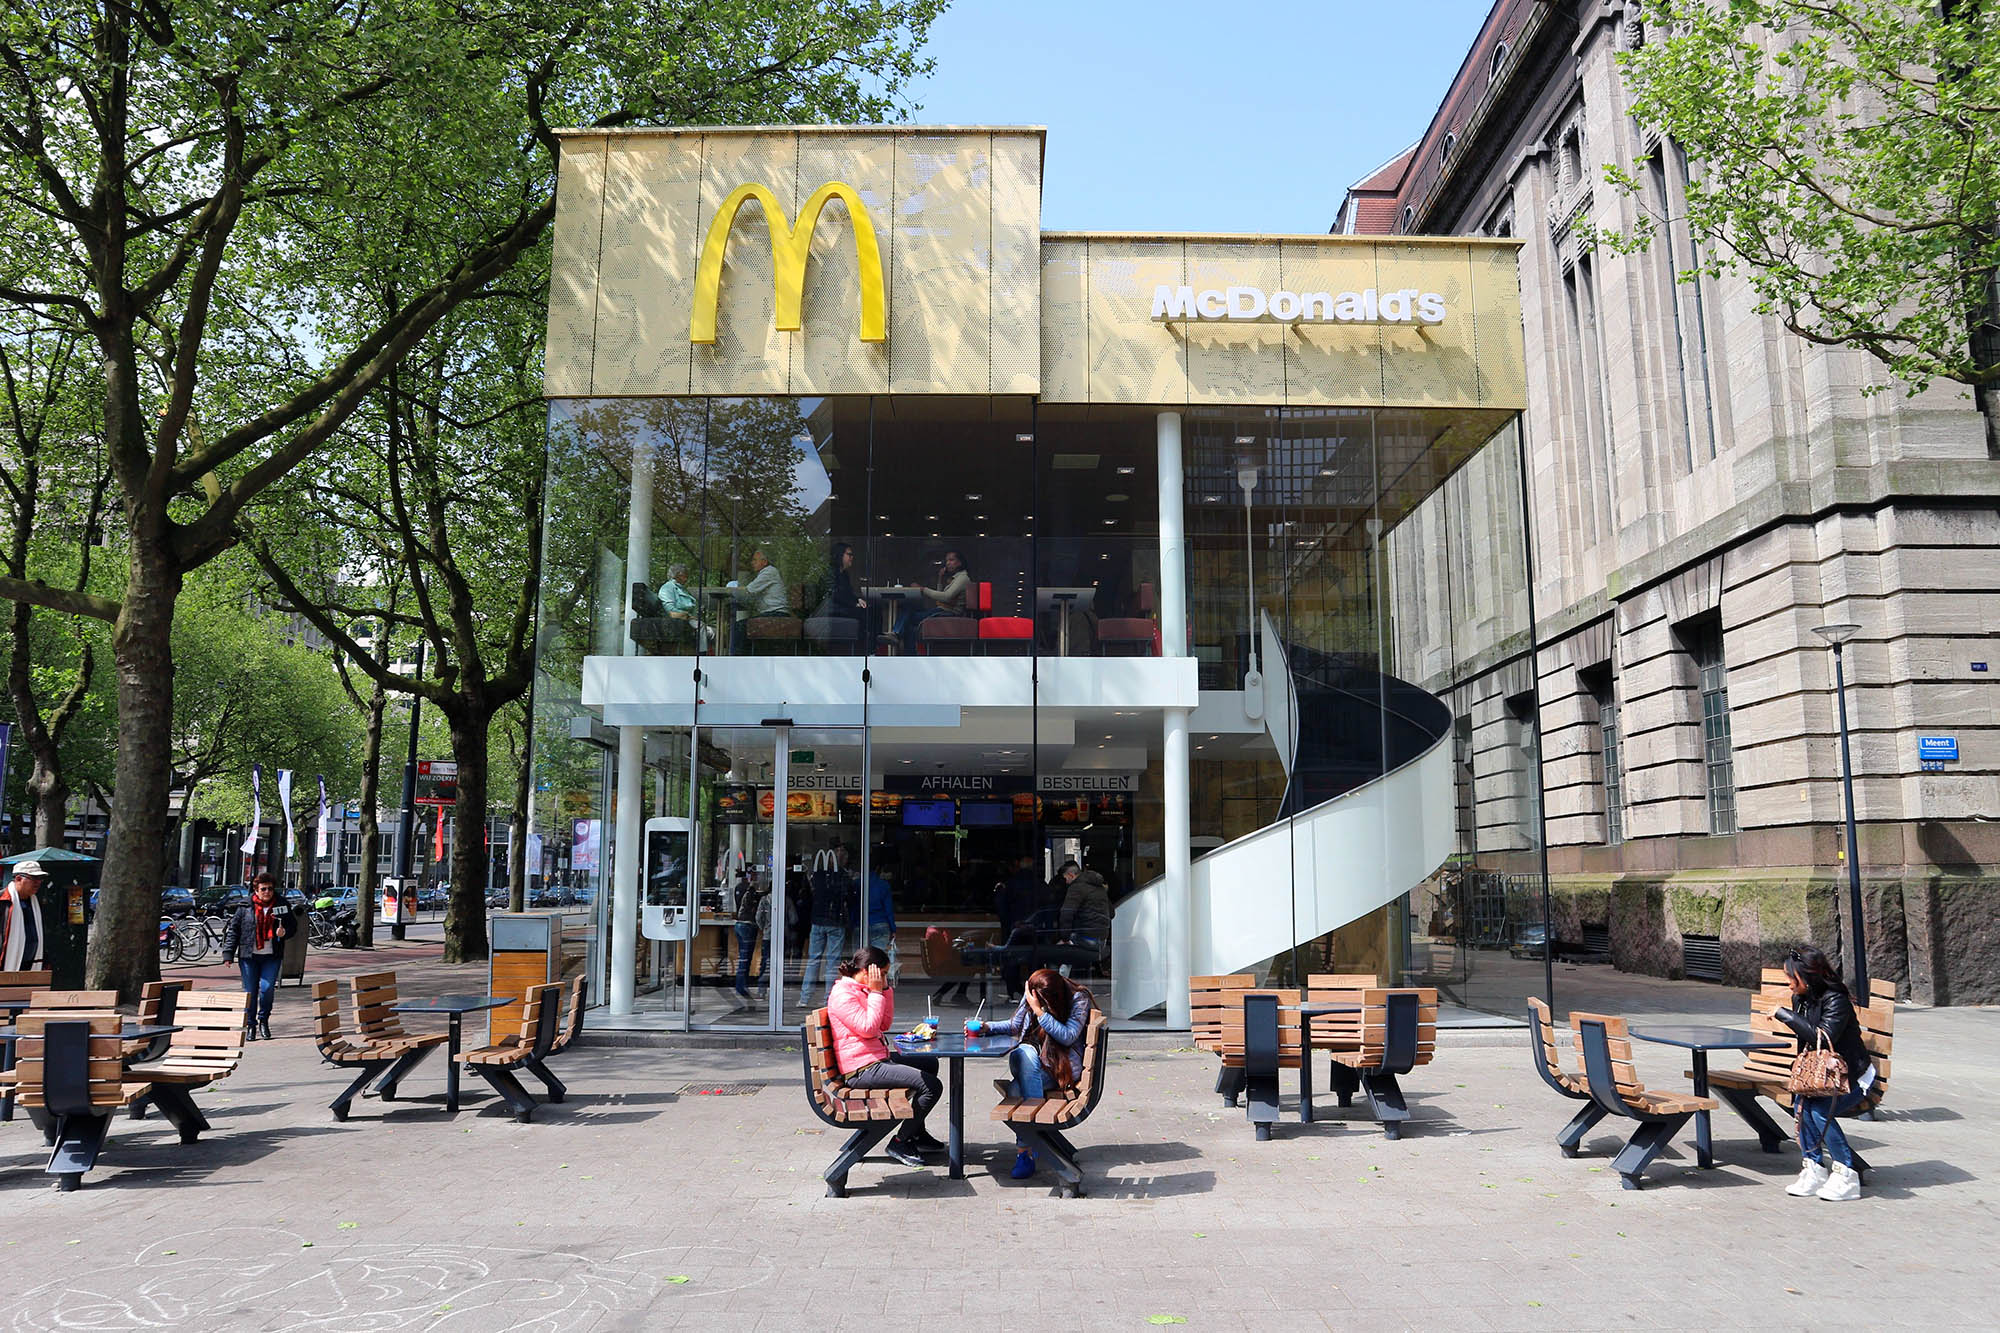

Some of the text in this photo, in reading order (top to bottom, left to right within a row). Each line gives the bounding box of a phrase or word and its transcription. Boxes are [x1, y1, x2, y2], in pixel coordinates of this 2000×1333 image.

[1151, 285, 1446, 322] McDonald's
[787, 775, 863, 789] BESTELLE
[921, 776, 993, 789] AFHALEN
[1043, 777, 1130, 789] BESTELLEN
